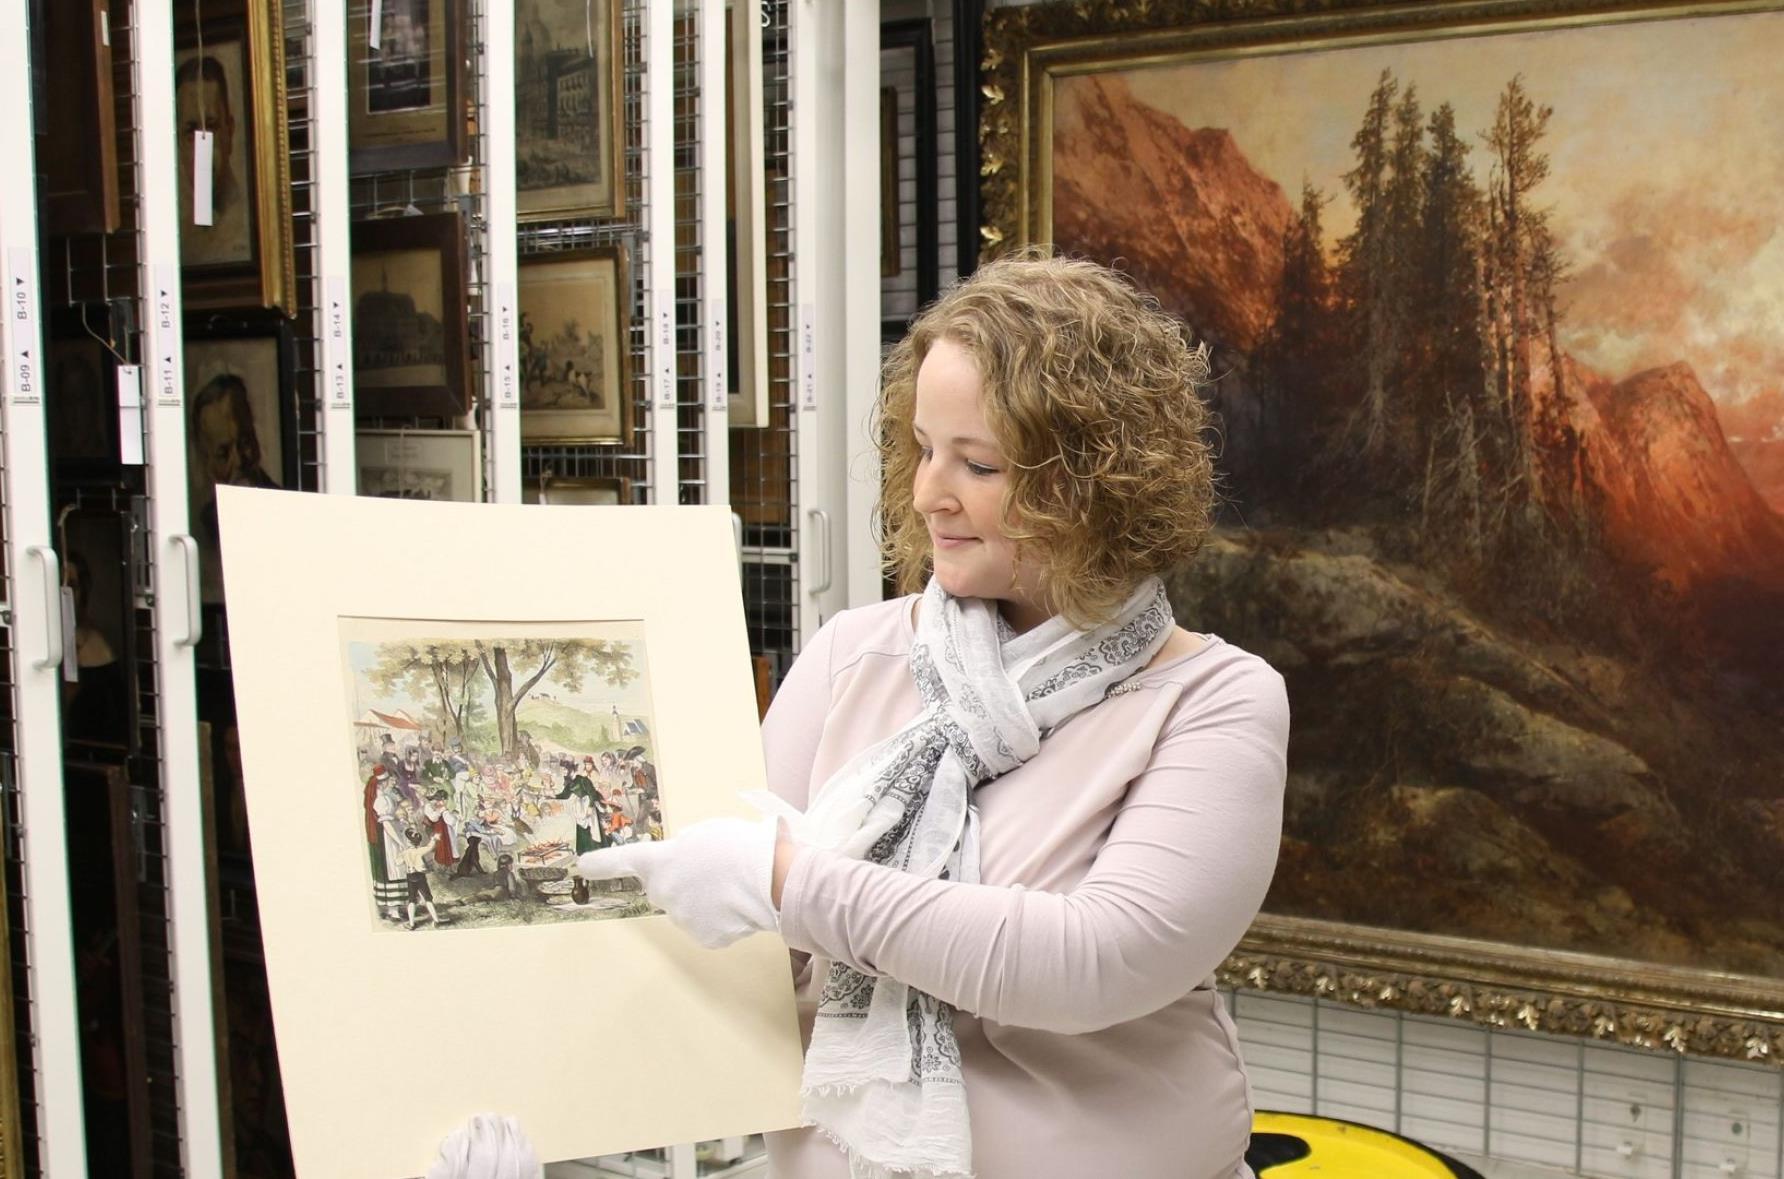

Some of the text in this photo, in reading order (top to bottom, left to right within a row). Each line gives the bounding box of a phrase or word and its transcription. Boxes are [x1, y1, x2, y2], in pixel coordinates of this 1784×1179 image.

[333, 314, 341, 337] B-14
[502, 318, 510, 340] B-16
[16, 292, 31, 392] B-09 B-10
[160, 303, 173, 394] B-11 B-12
[335, 375, 344, 399] B-13
[504, 376, 512, 398] B-15
[663, 379, 671, 400] B-17
